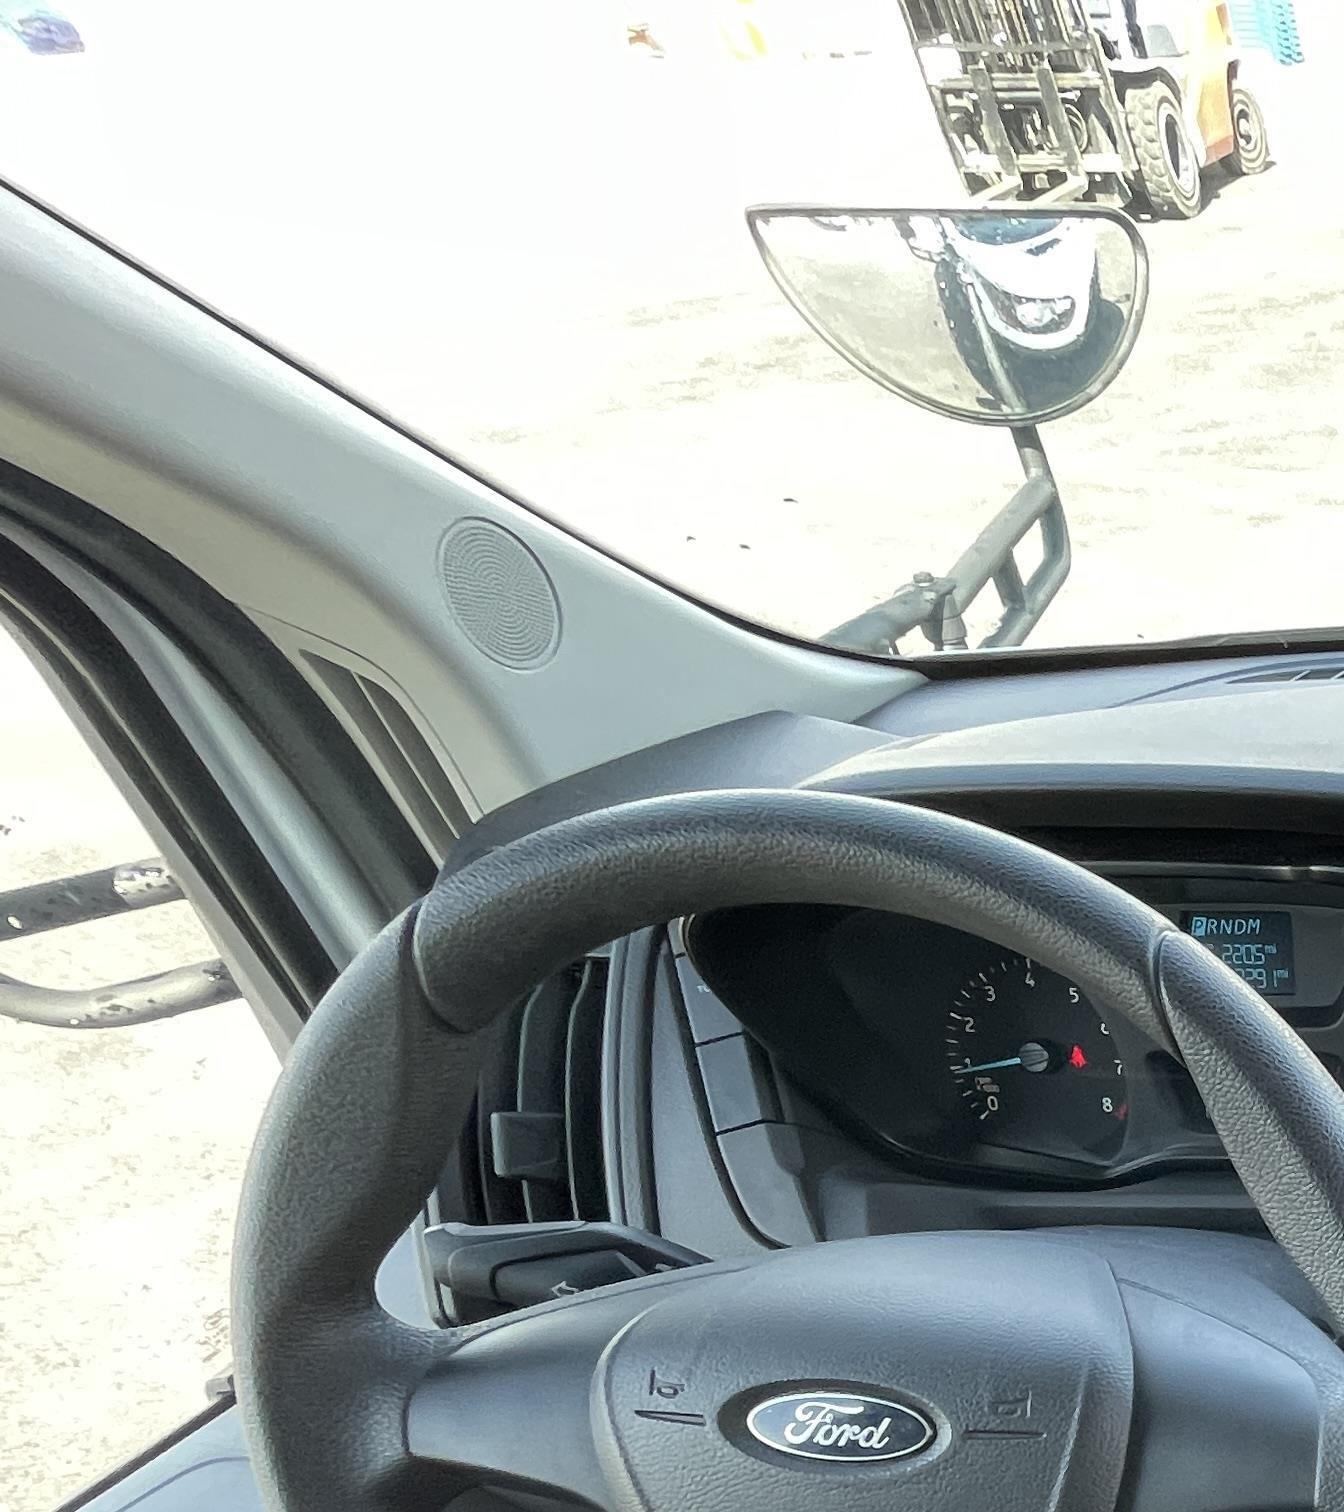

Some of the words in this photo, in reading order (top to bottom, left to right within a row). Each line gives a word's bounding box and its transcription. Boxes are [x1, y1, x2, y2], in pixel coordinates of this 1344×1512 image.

[985, 985, 996, 1002] 3
[1069, 987, 1080, 1003] 5
[964, 1017, 976, 1033] 2
[987, 1096, 998, 1110] 0
[1102, 1097, 1113, 1112] 8
[784, 1401, 892, 1449] Ford
